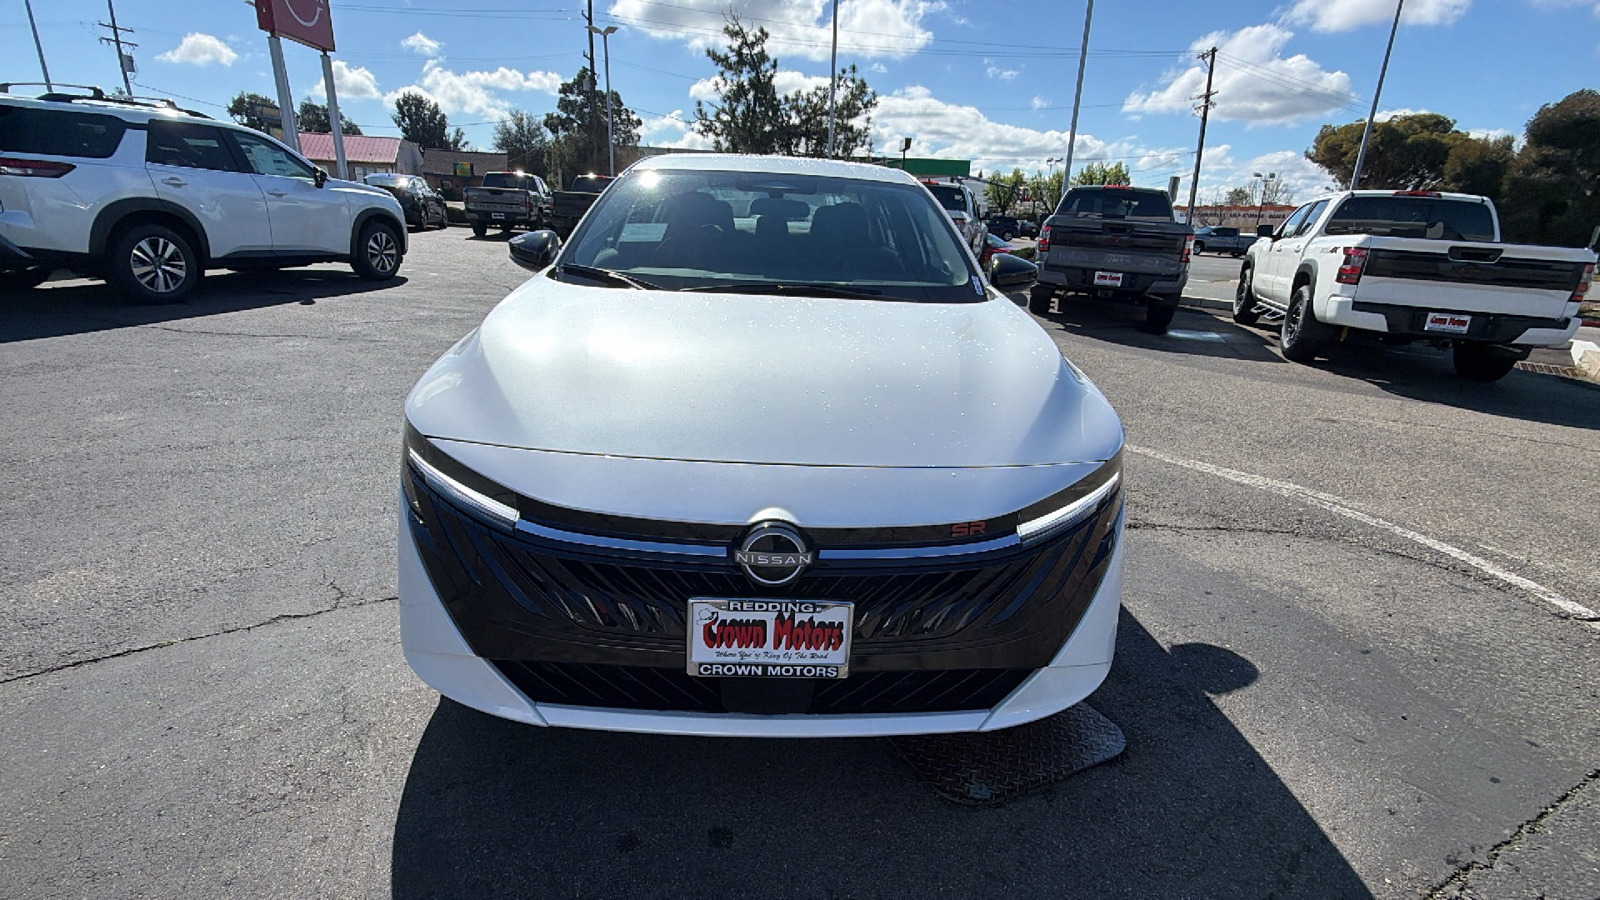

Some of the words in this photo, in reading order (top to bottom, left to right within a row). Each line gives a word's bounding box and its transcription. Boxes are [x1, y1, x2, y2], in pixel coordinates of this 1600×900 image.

[951, 521, 986, 538] SR
[736, 552, 811, 565] NISSAN
[729, 602, 814, 612] REDDING
[703, 612, 767, 649] Crown
[773, 611, 843, 651] Motors
[763, 651, 781, 660] King
[783, 652, 794, 660] Of
[700, 664, 762, 676] CROWN
[767, 666, 838, 677] MOTORS
